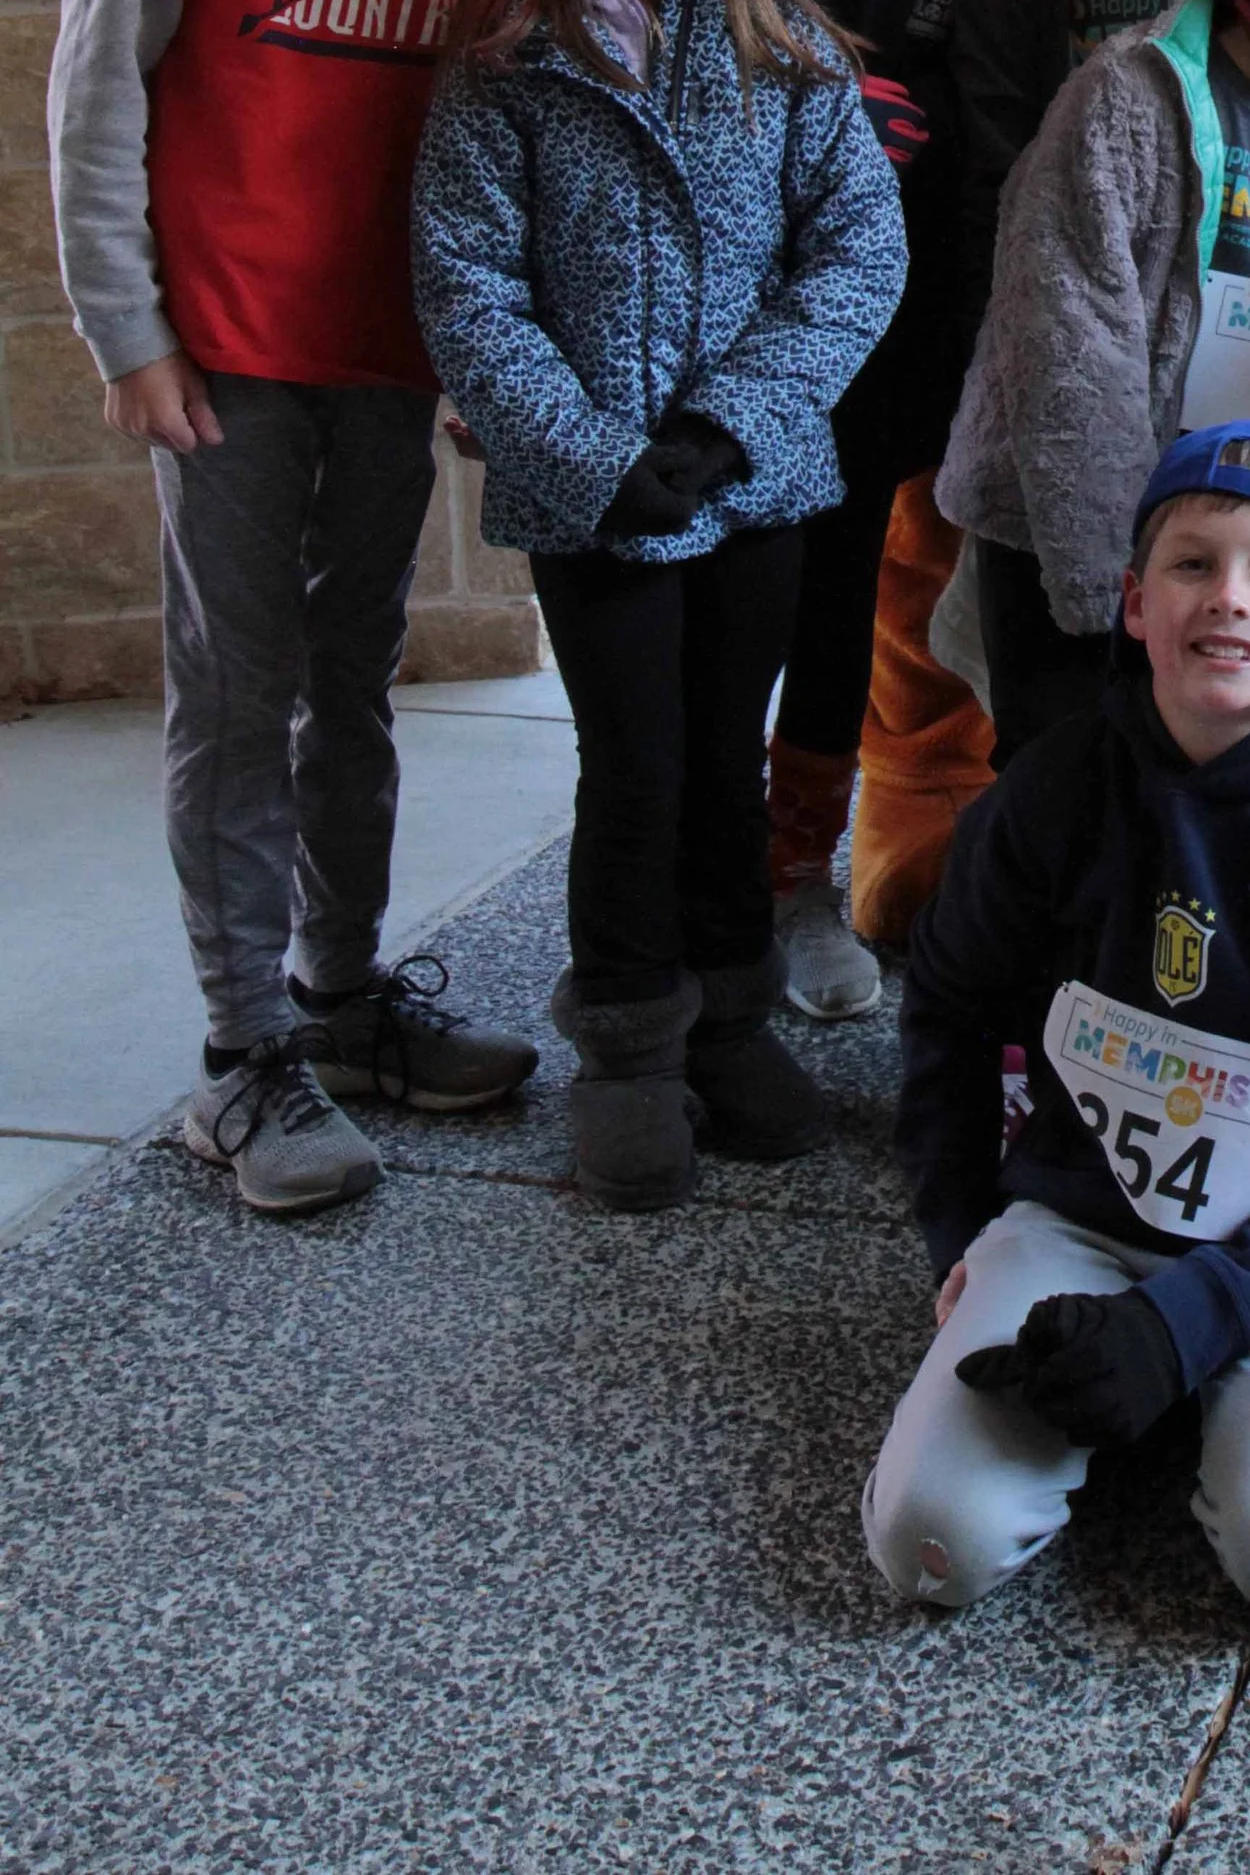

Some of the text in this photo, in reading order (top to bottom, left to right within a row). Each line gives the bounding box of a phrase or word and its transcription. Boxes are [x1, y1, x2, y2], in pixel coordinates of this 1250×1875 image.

[1102, 1004, 1178, 1046] Happy in
[1073, 1019, 1250, 1108] MEMPHIS
